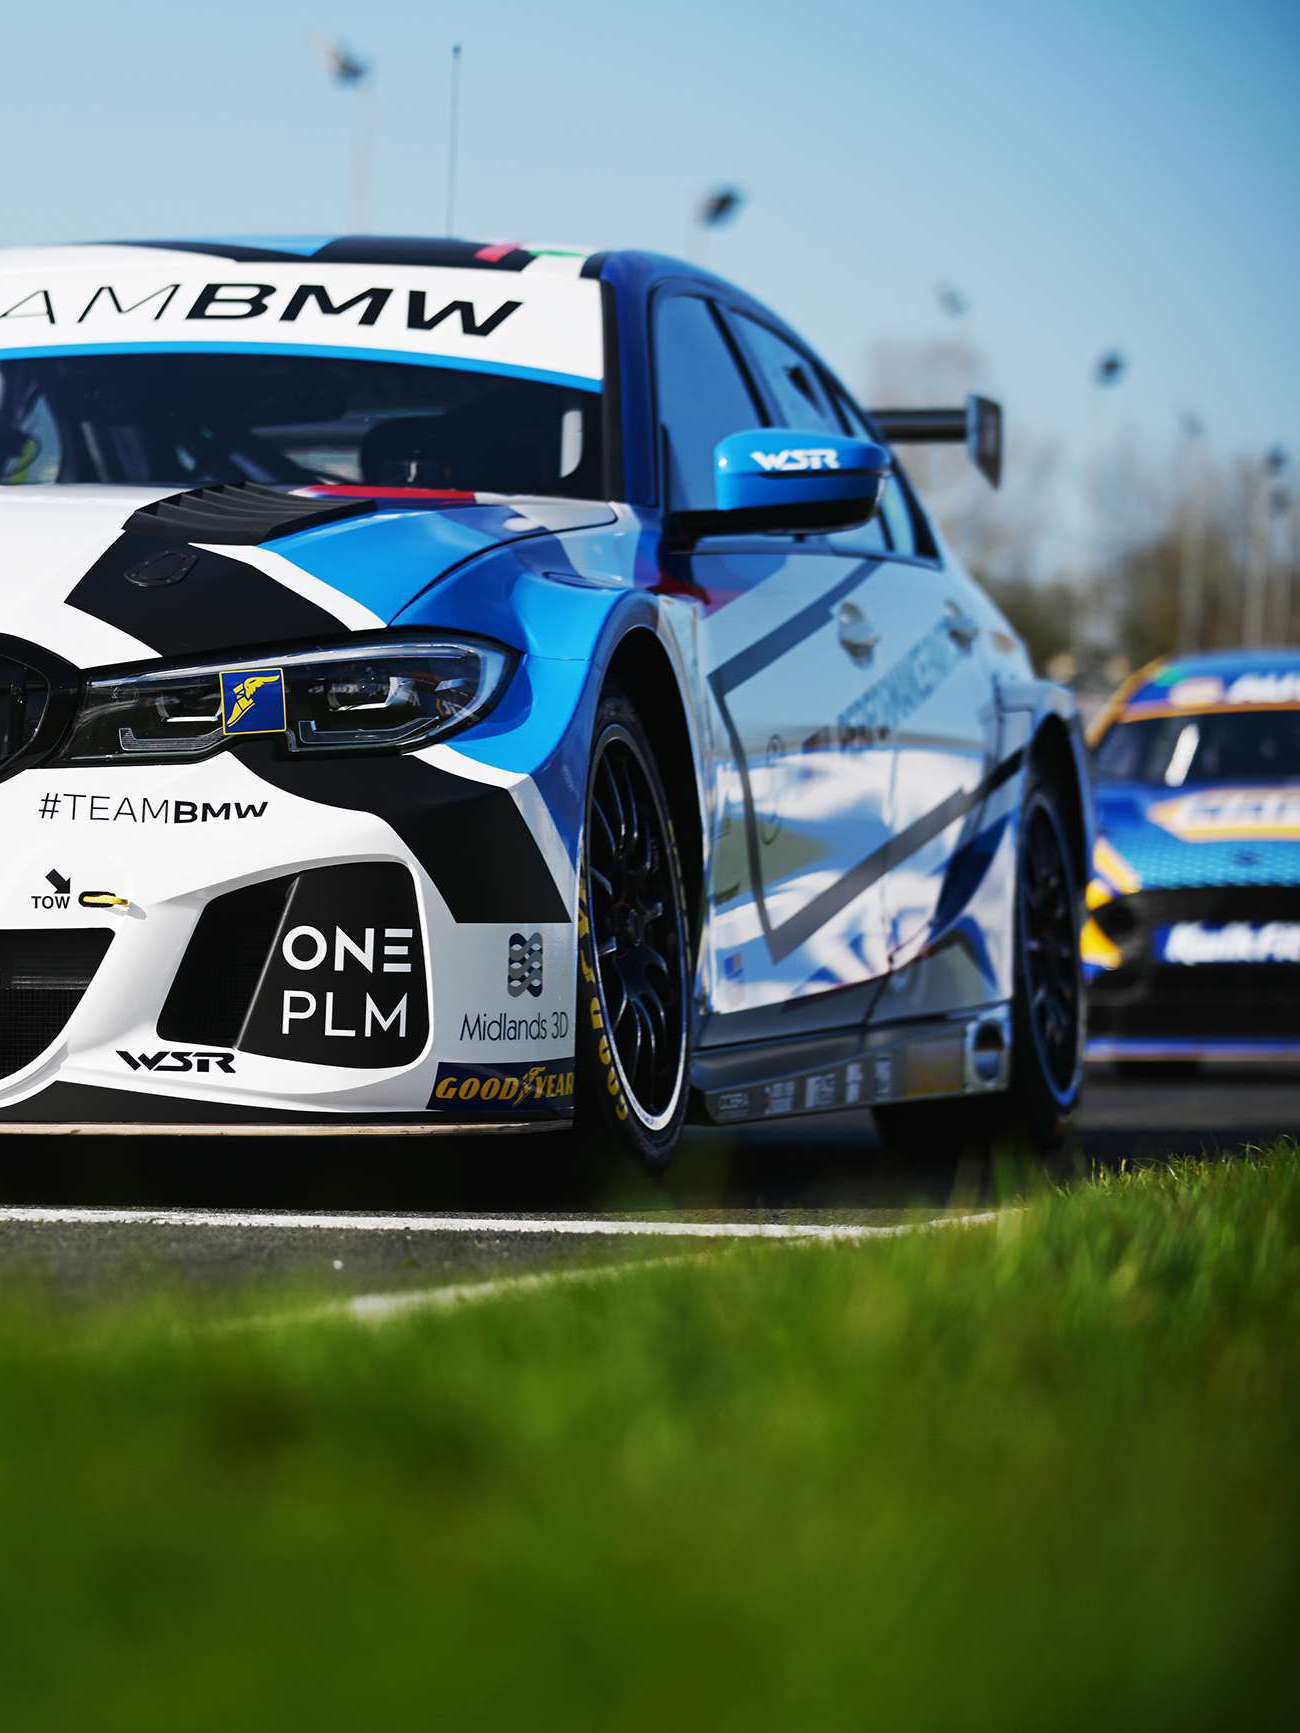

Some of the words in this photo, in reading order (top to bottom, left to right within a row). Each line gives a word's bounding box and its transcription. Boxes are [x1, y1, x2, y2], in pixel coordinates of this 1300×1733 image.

[750, 448, 840, 470] WSR
[38, 793, 268, 824] #TEAMBMW
[31, 897, 70, 910] TOW
[282, 925, 413, 973] ONE
[282, 990, 407, 1038] PLM
[459, 1012, 547, 1041] Midlands
[550, 1011, 569, 1039] 3D
[115, 1050, 237, 1074] WSR
